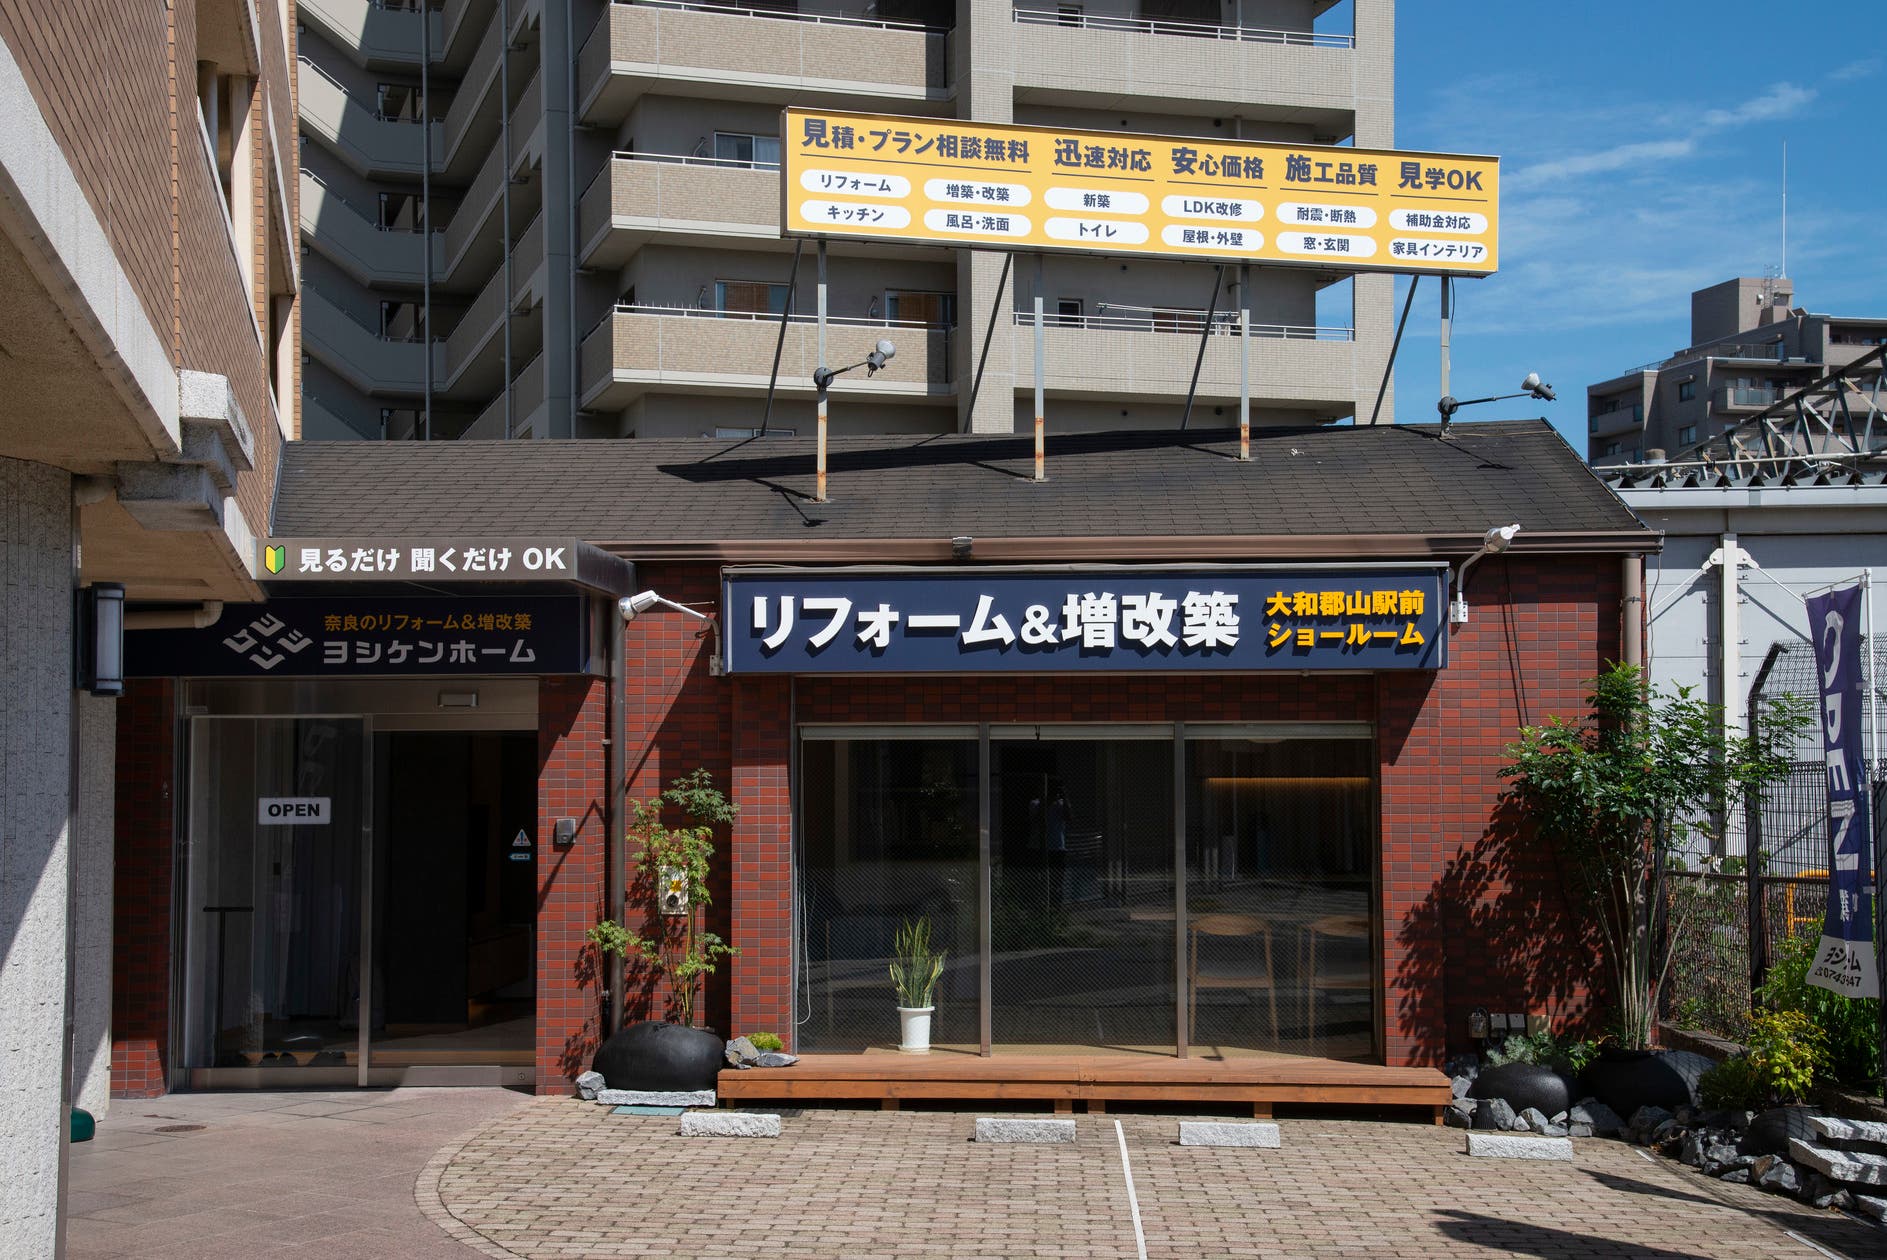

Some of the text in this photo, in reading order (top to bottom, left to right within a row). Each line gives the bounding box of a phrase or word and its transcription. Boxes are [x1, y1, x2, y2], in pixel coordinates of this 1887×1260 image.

[801, 118, 1030, 164] 見積・プラン相談無料
[1054, 138, 1152, 171] 迅速対応
[1171, 147, 1264, 180] 安心価格
[1285, 153, 1378, 186] 施工品質
[1398, 161, 1483, 191] 見学OK
[821, 174, 892, 192] リフォーム
[946, 183, 1010, 201] 増築・改築
[1083, 193, 1111, 208] 新築
[1183, 199, 1242, 217] LDK改修
[827, 205, 885, 222] キッチン
[946, 214, 1010, 231] 風呂・洗面
[1296, 207, 1357, 223] 耐震・断熱
[1406, 213, 1471, 230] 補助金対応
[1079, 223, 1117, 237] トイレ
[1182, 229, 1243, 246] 屋根・外壁
[1303, 236, 1350, 252] 窓・玄関
[1392, 241, 1483, 258] 家具インテリア
[299, 547, 566, 572] 見るだけ 聞くだけ OK
[1266, 589, 1425, 616] 大和郡山駅前
[324, 612, 532, 632] 奈良のリフォーム&増改築
[754, 590, 1240, 649] リフォーム&増改築
[1268, 622, 1425, 648] ショールーム
[323, 639, 536, 664] ヨシケンホーム
[268, 804, 320, 817] OPEN
